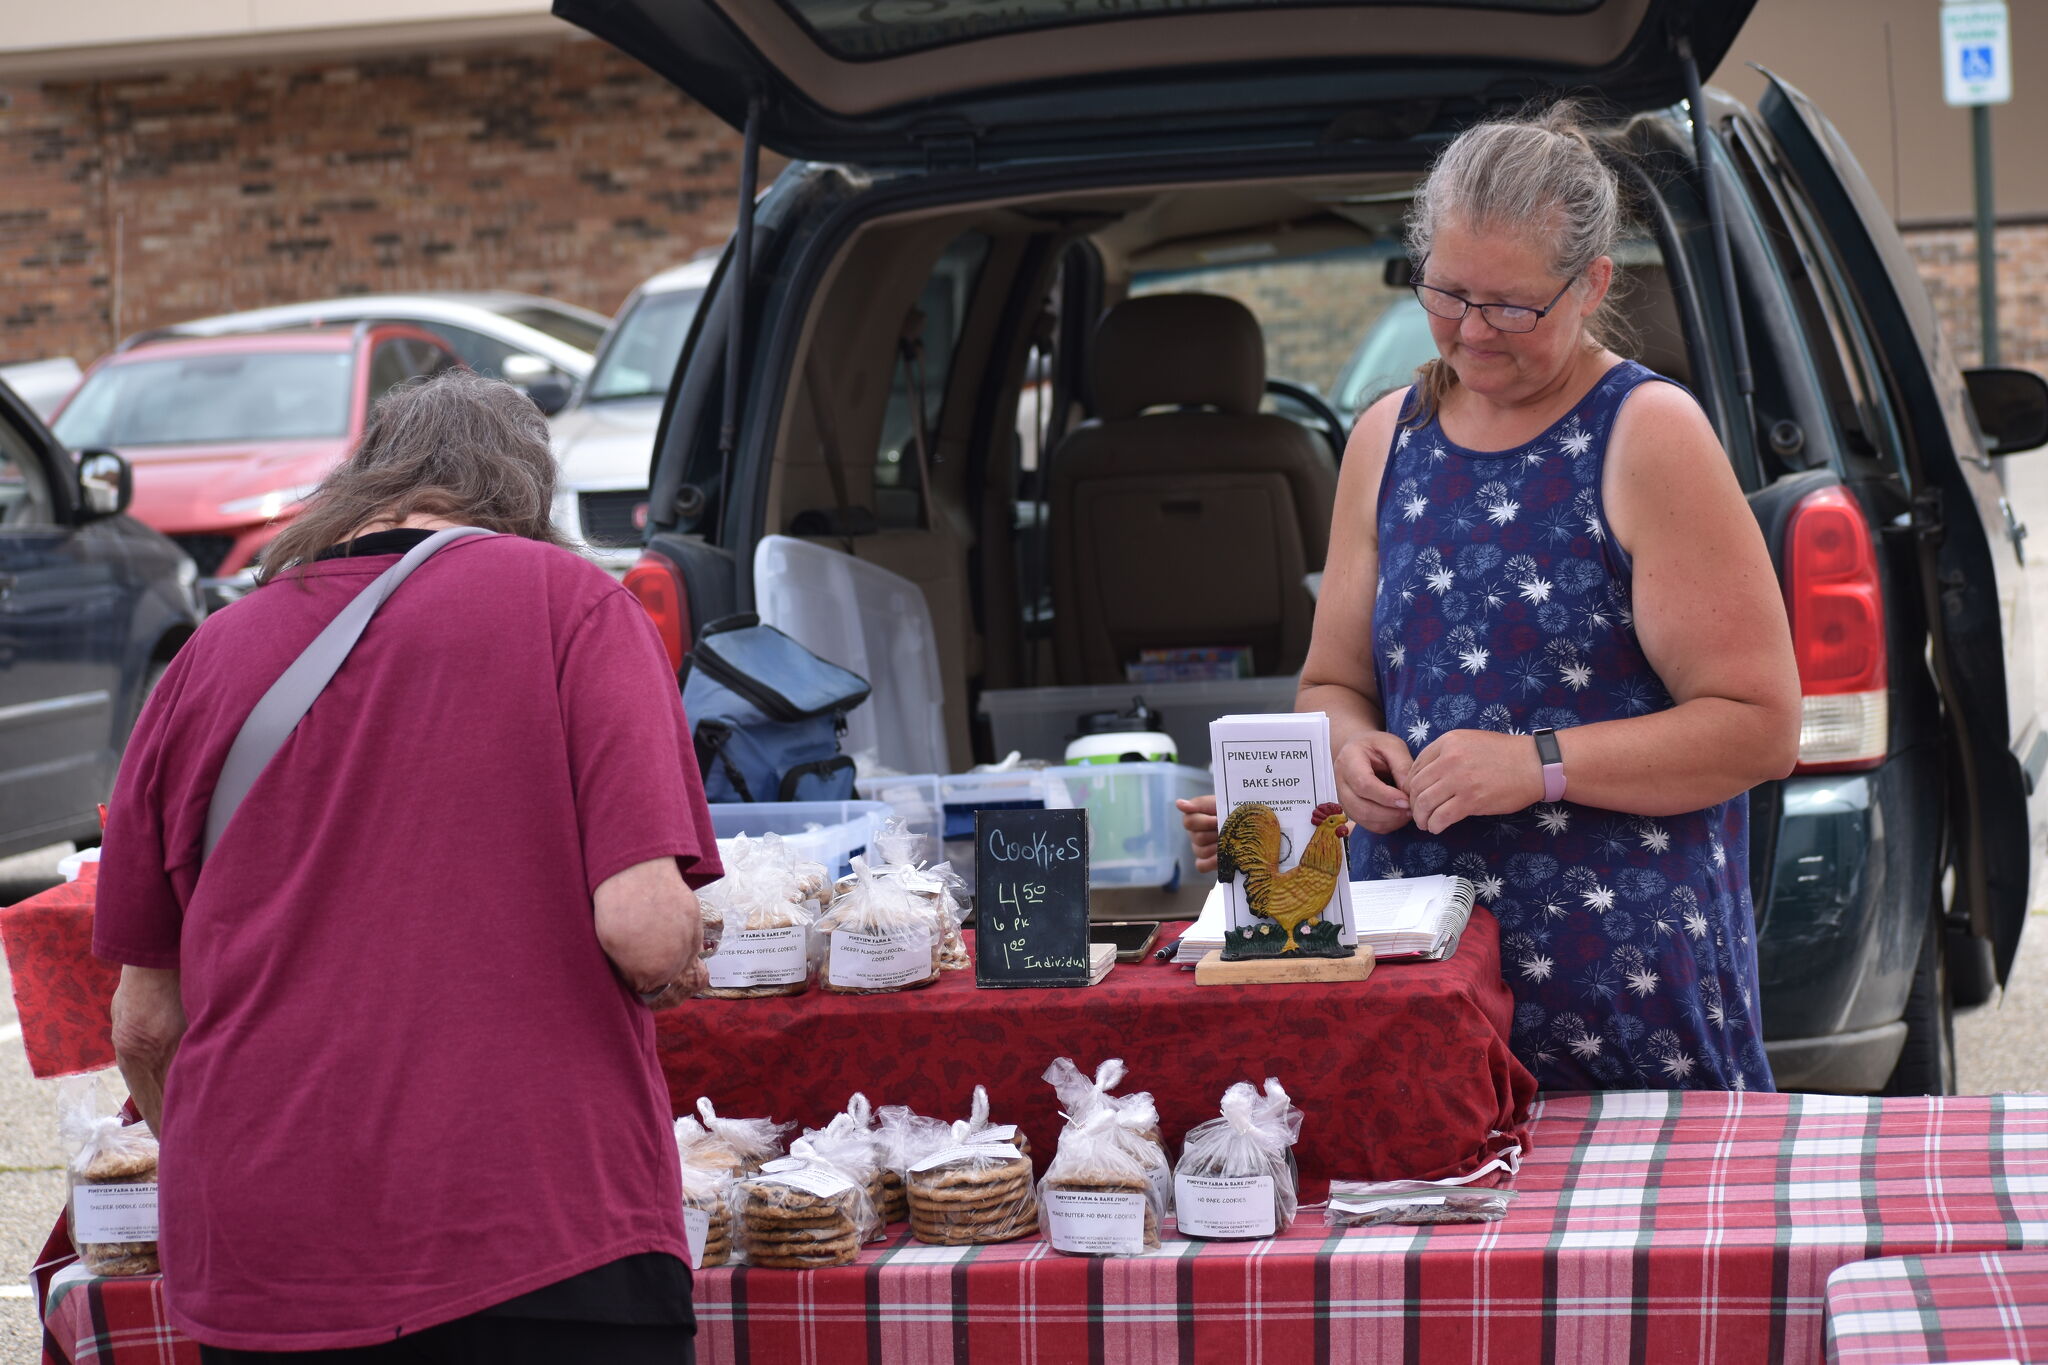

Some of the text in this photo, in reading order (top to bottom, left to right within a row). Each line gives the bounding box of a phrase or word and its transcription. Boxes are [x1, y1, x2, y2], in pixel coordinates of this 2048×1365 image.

[1228, 750, 1308, 760] PINEVIEW FARM
[1265, 764, 1272, 774] &
[1242, 778, 1300, 788] BAKE SHOP
[993, 917, 1004, 930] 6
